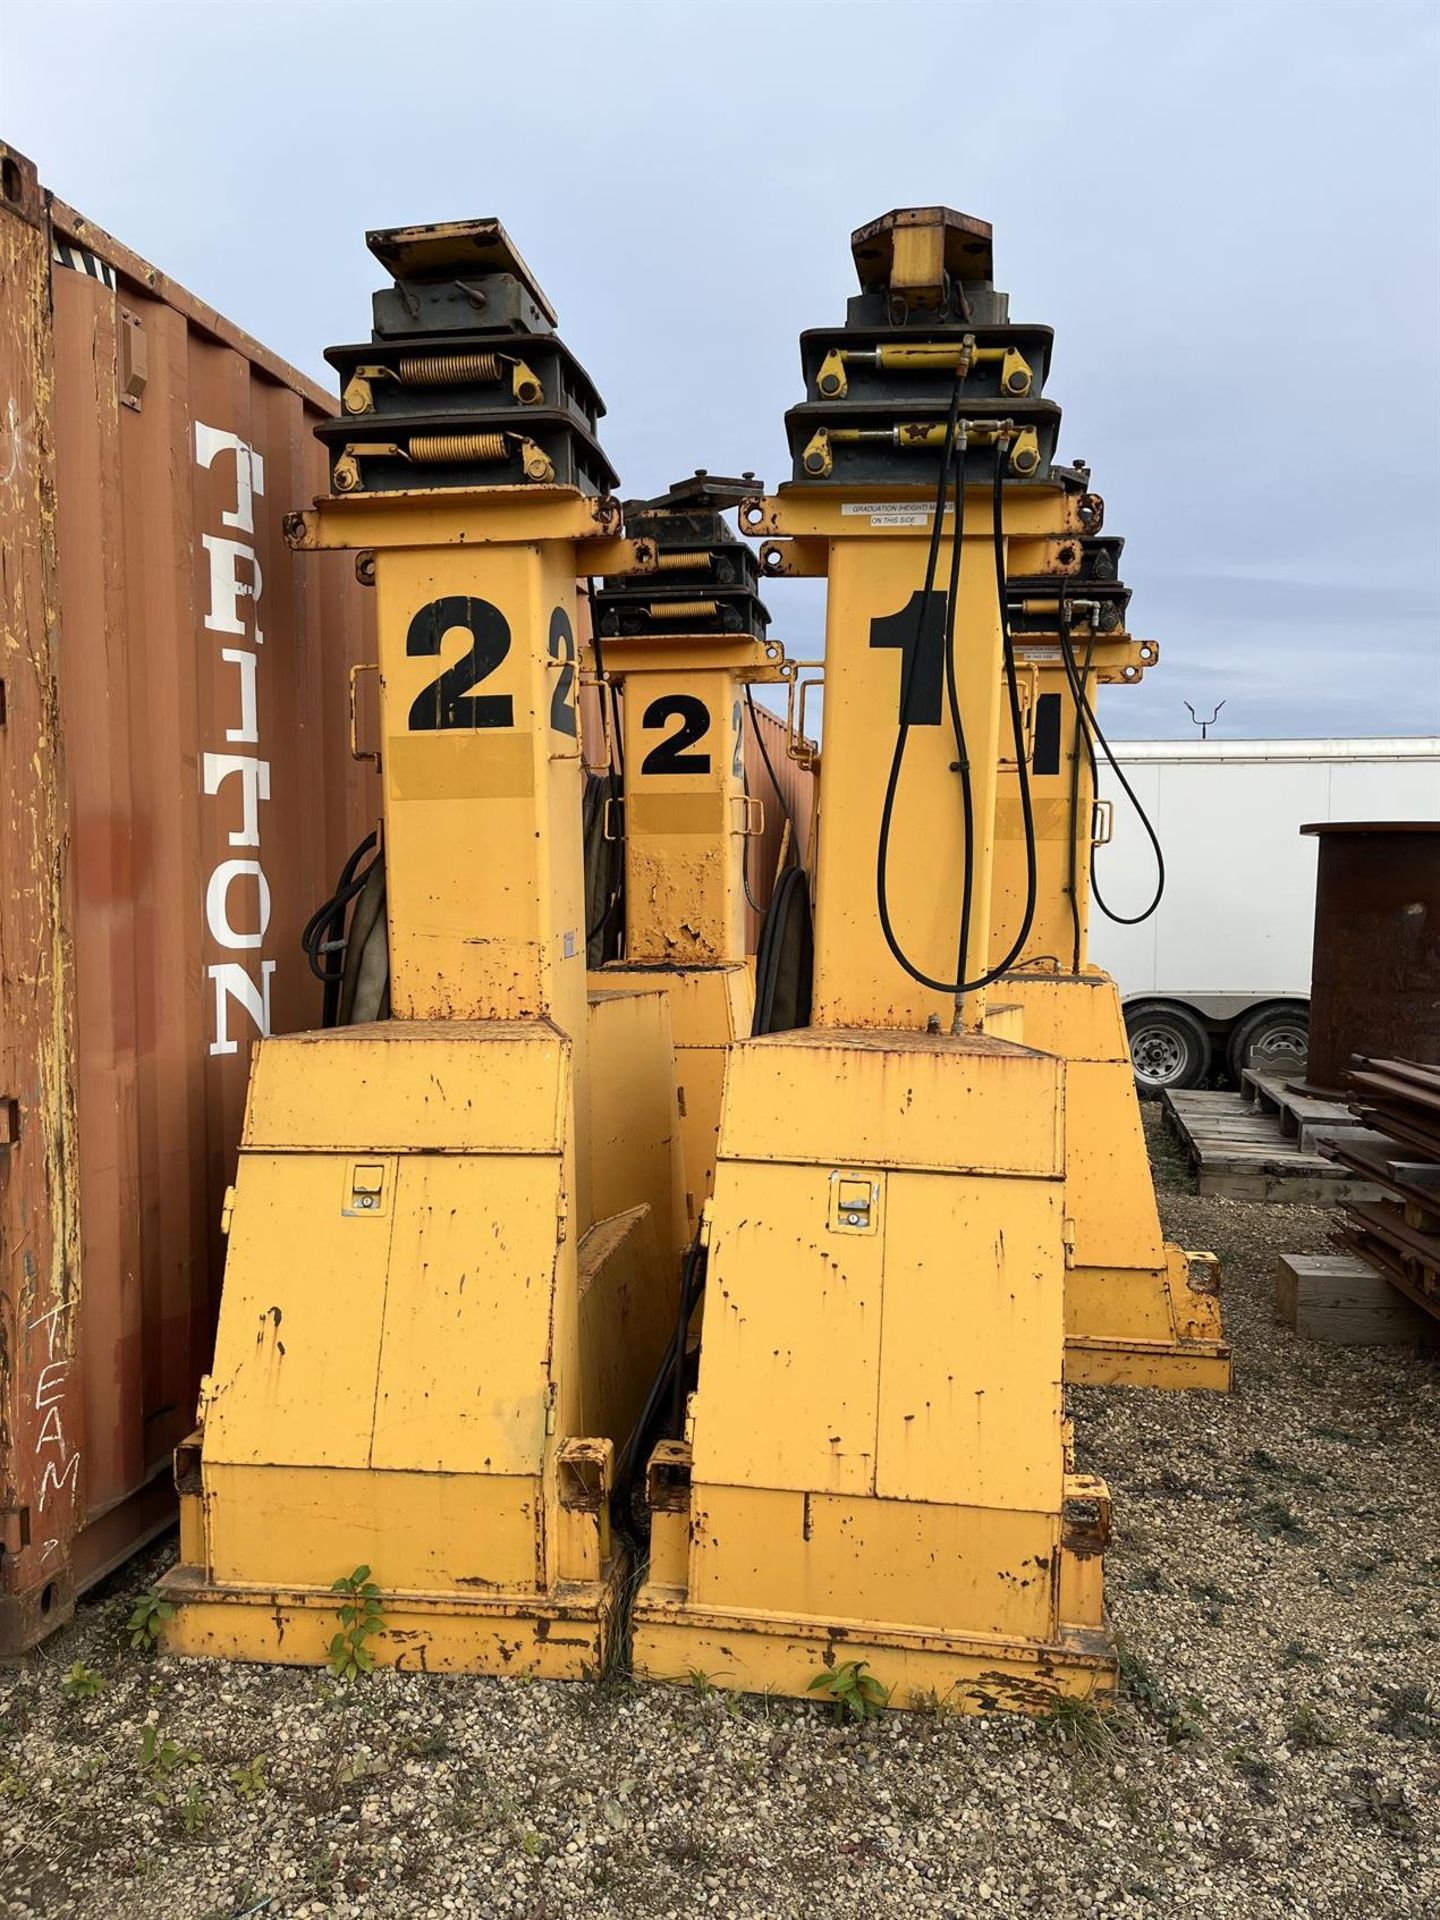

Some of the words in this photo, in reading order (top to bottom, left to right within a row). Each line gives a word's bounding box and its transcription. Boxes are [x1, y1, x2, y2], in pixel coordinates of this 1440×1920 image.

[853, 505, 897, 513] GRADUATION
[900, 516, 914, 524] SIDE
[406, 595, 514, 731] 2
[549, 606, 577, 738] 2
[869, 590, 948, 726] 1
[194, 420, 277, 1056] TRITON
[642, 694, 711, 775] 2
[29, 1302, 81, 1512] TEAM
